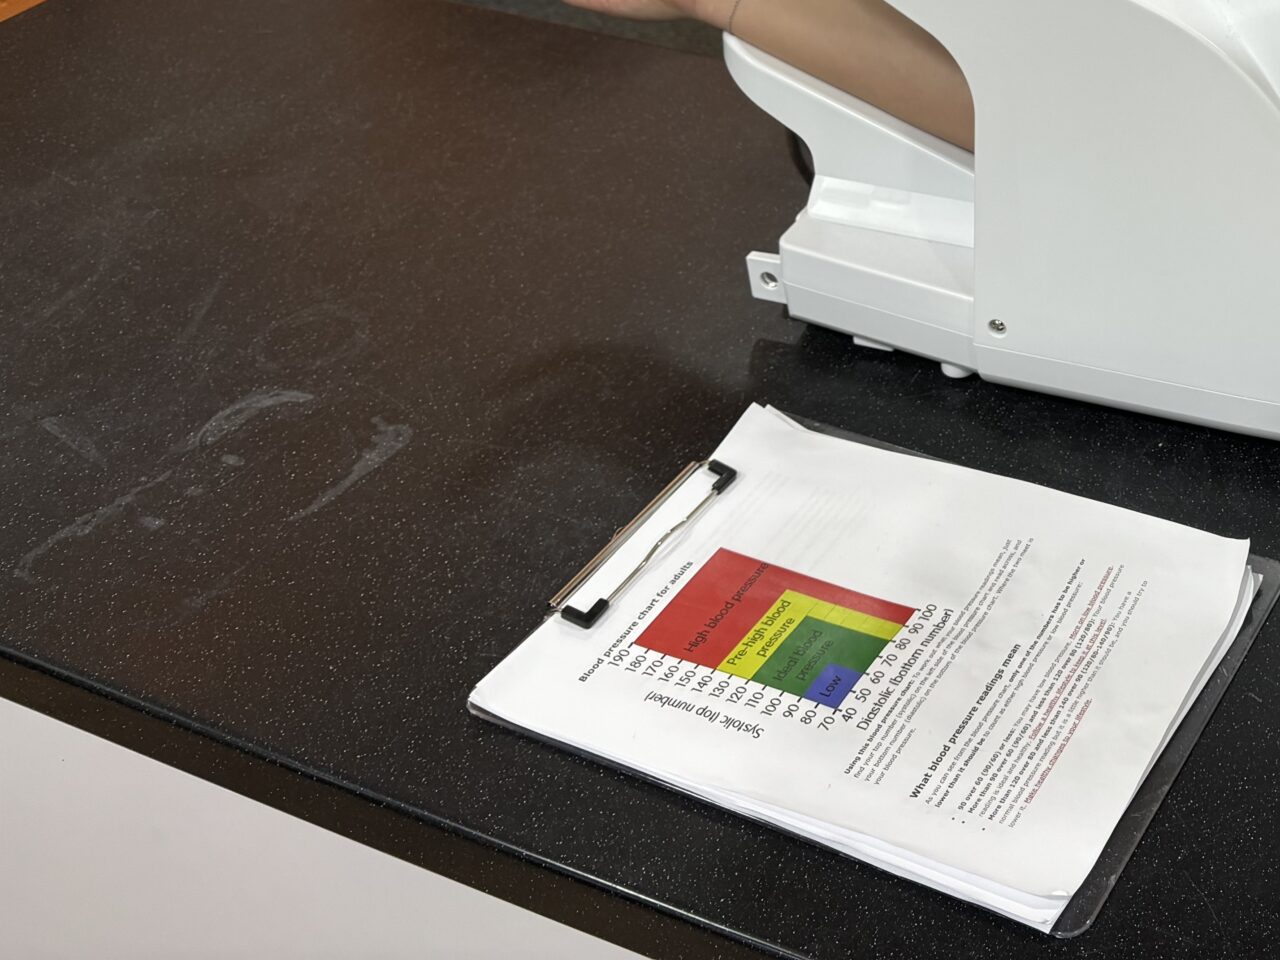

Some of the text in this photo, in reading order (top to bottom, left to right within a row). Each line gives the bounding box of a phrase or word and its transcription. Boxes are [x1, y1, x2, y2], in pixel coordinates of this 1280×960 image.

[683, 562, 770, 652] High blood pressure
[578, 561, 693, 682] Blood pressure chart for adults
[726, 599, 791, 665] Pre-high blood
[756, 617, 795, 657] pressure
[607, 648, 629, 666] 190
[624, 654, 646, 672] 180
[772, 629, 822, 681] Ideal blood
[794, 640, 833, 681] pressure
[841, 603, 937, 722] 40 50 60 70 80 90 100
[641, 659, 663, 676] 170
[657, 665, 679, 681] 160
[856, 608, 953, 730] Diastolic (bottom number)
[674, 670, 696, 686] 150
[690, 675, 712, 692] 140
[818, 675, 841, 697] Low
[708, 680, 729, 697] 130
[725, 685, 746, 703] 120
[743, 691, 764, 707] 110
[760, 697, 781, 715] 100
[643, 690, 764, 738] Systolic (top number)
[782, 703, 799, 717] 90
[799, 709, 816, 724] 80
[909, 643, 1020, 797] What blood pressure readings mean
[816, 716, 835, 730] 70
[843, 679, 914, 774] Using this blood pressure chart:
[957, 727, 1016, 810] 90 over 60 (90/60) or less:
